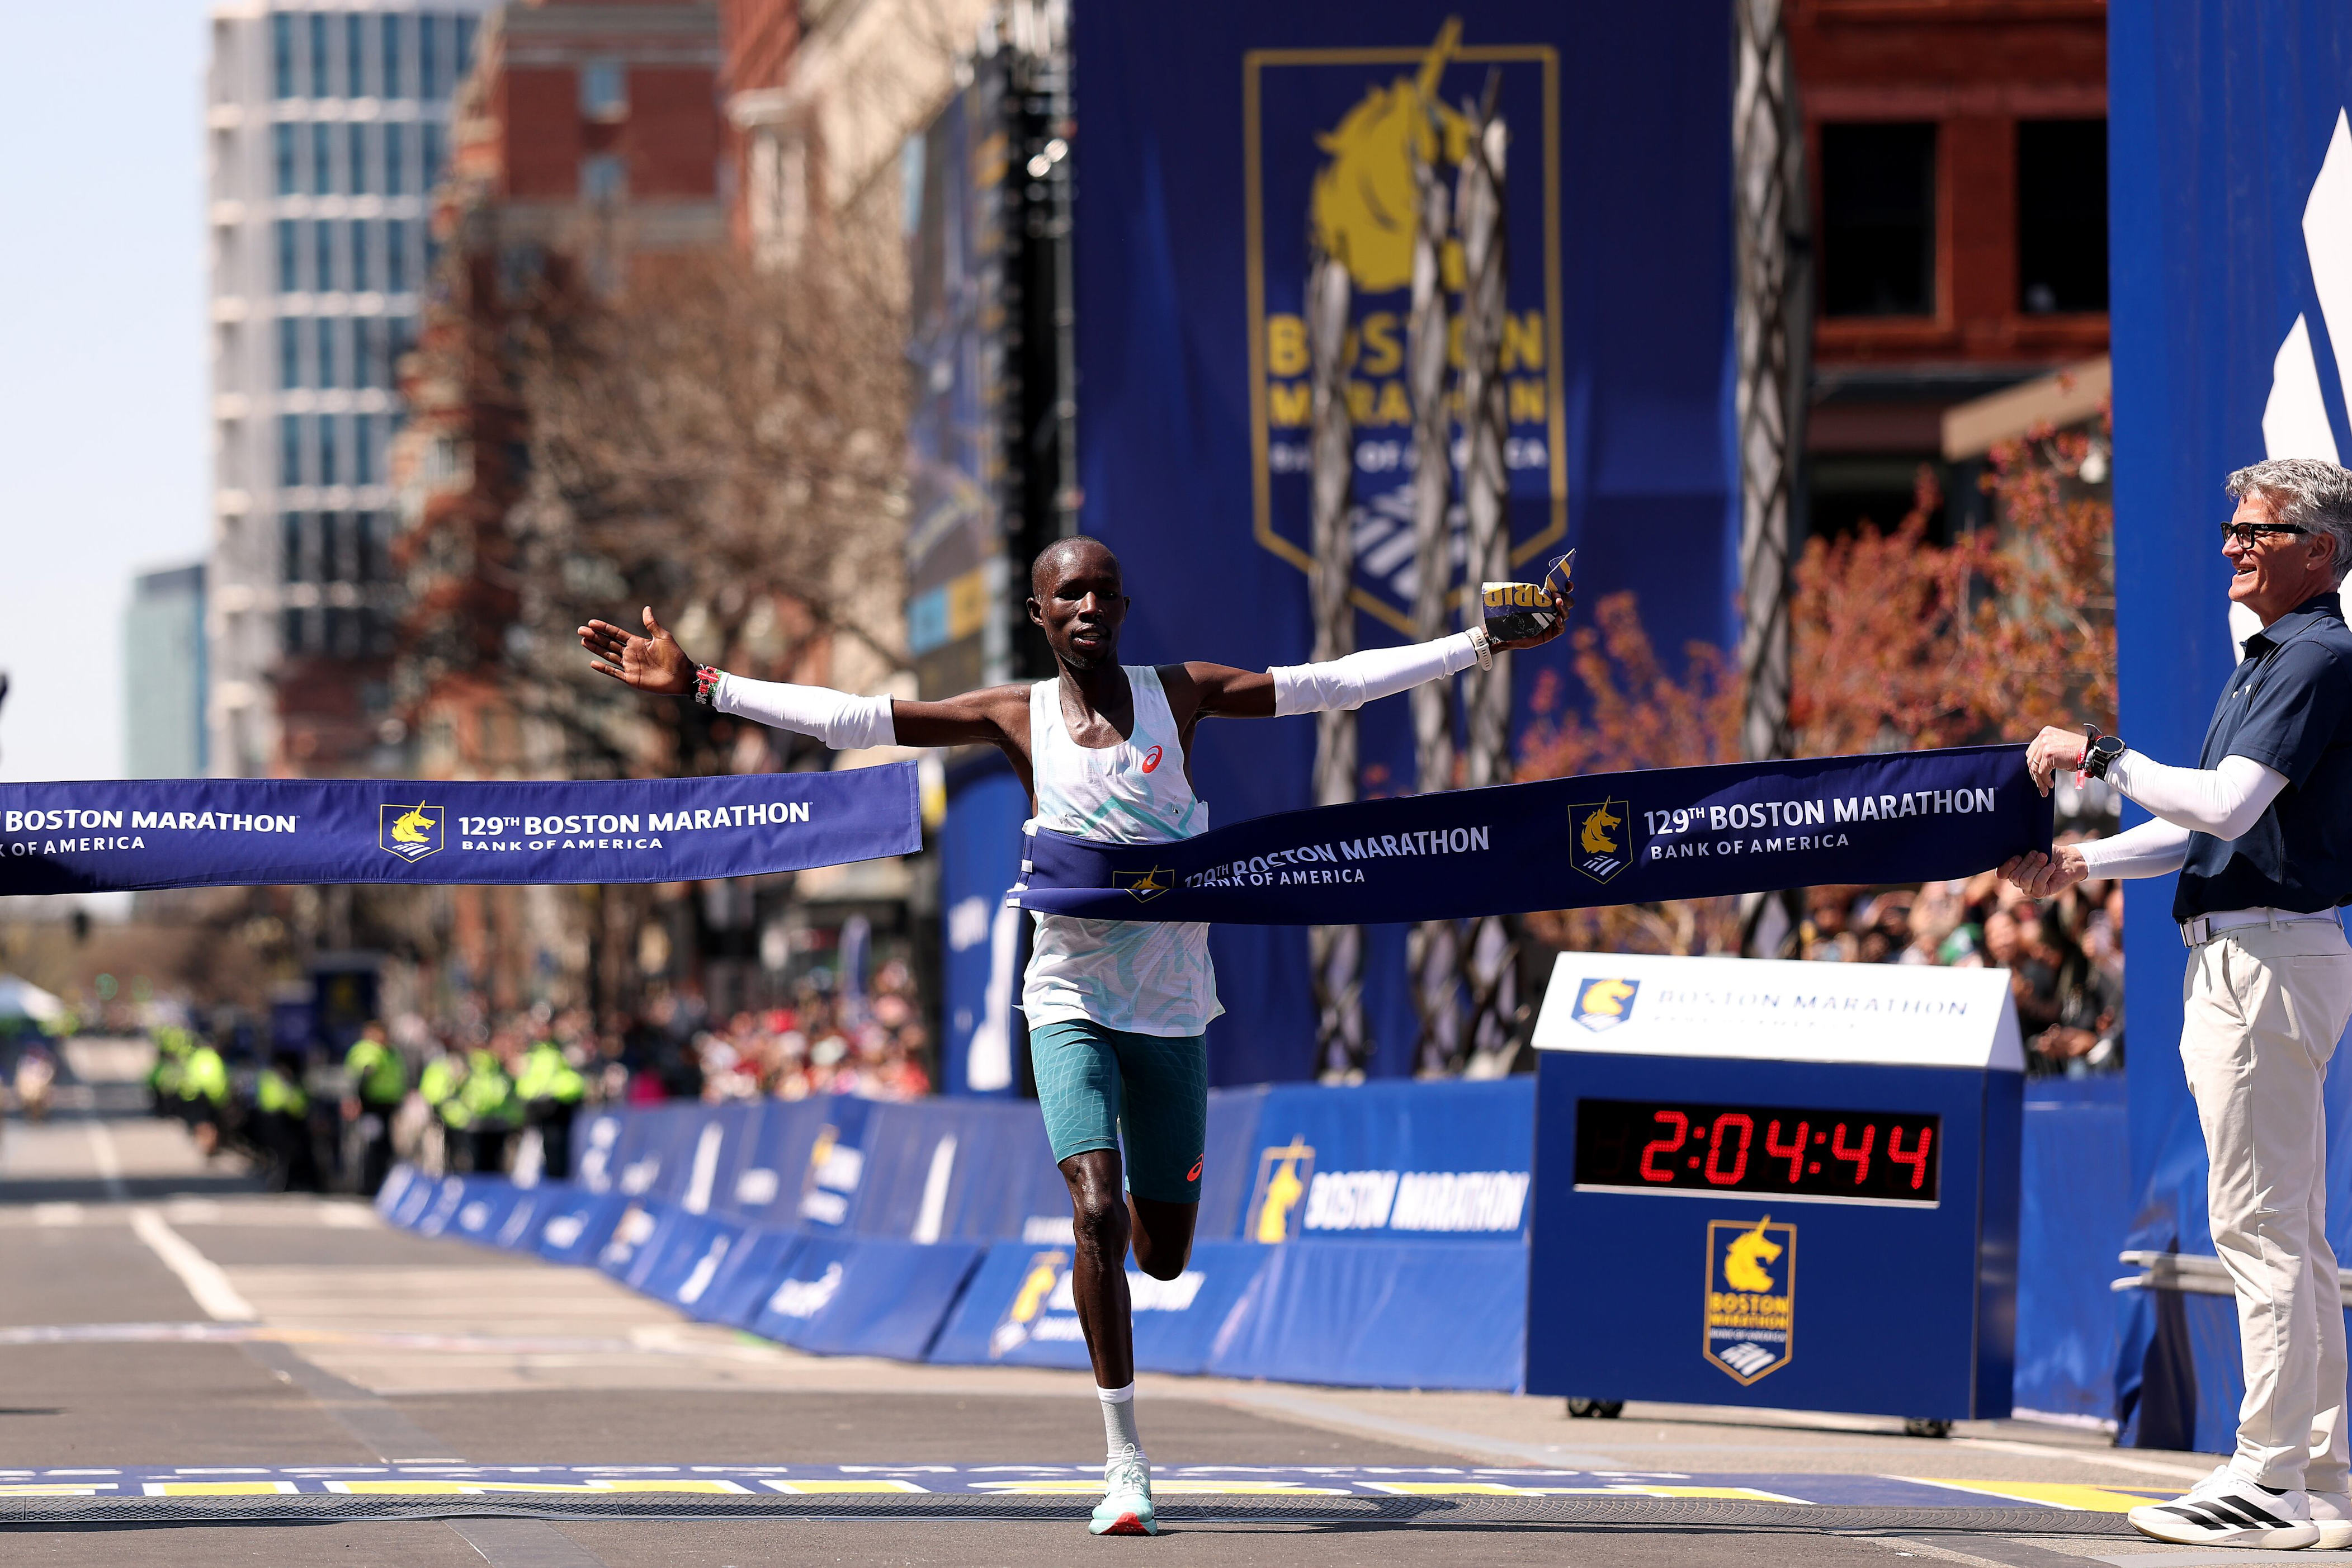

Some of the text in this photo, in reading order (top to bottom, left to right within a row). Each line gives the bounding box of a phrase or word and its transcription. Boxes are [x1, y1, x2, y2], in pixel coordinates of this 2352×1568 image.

[5, 809, 296, 833] BOSTON MARATHON
[458, 802, 810, 836] 129TH BOSTON MARATHON
[1644, 787, 1995, 835] 129TH BOSTON MARATHON
[11, 842, 37, 856] OF
[43, 836, 145, 854] AMERICA
[462, 838, 663, 851] BANK OF AMERICA
[1340, 826, 1489, 860] MARATHON
[1651, 834, 1849, 860] BANK OF AMERICA
[1250, 872, 1273, 886] OF
[1279, 868, 1365, 885] AMERICA
[1793, 994, 1968, 1017] MARATHON
[1639, 1110, 1933, 1190] 2:04:44
